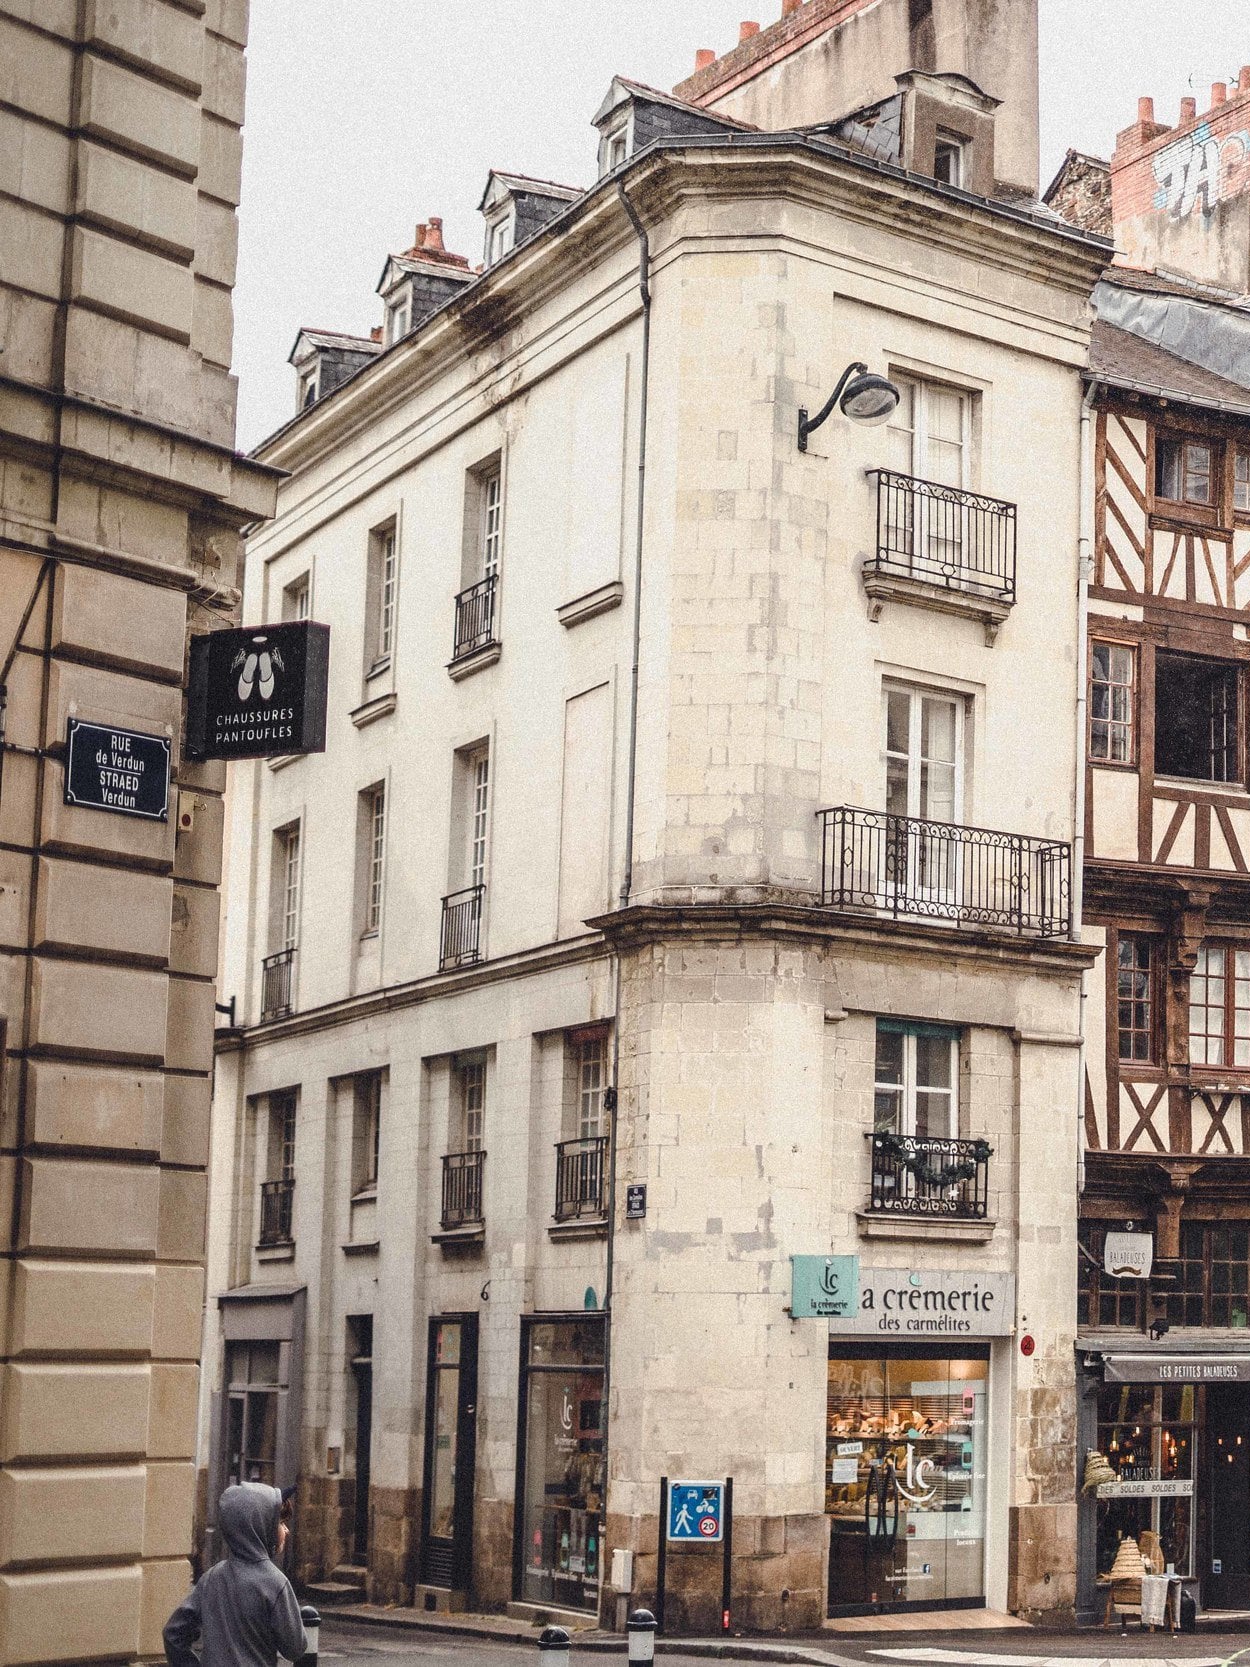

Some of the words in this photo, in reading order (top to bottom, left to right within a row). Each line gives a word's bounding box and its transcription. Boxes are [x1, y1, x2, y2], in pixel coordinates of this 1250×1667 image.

[215, 708, 294, 727] CHAUSSURES
[111, 735, 131, 752] RUE
[215, 726, 293, 744] PANTOUFLES
[96, 751, 108, 766] de
[111, 753, 145, 772] Verdun
[100, 771, 139, 792] STRAED
[102, 789, 136, 808] Verdun
[857, 1287, 874, 1310] a
[879, 1313, 901, 1331] des
[907, 1314, 971, 1332] carmélites
[1160, 1366, 1172, 1378] LES
[1174, 1366, 1201, 1378] PETITES
[1204, 1365, 1238, 1377] BALADEUSES
[1120, 1485, 1145, 1493] SOLDES
[1152, 1484, 1176, 1492] SOLDES
[703, 1522, 714, 1530] 20
